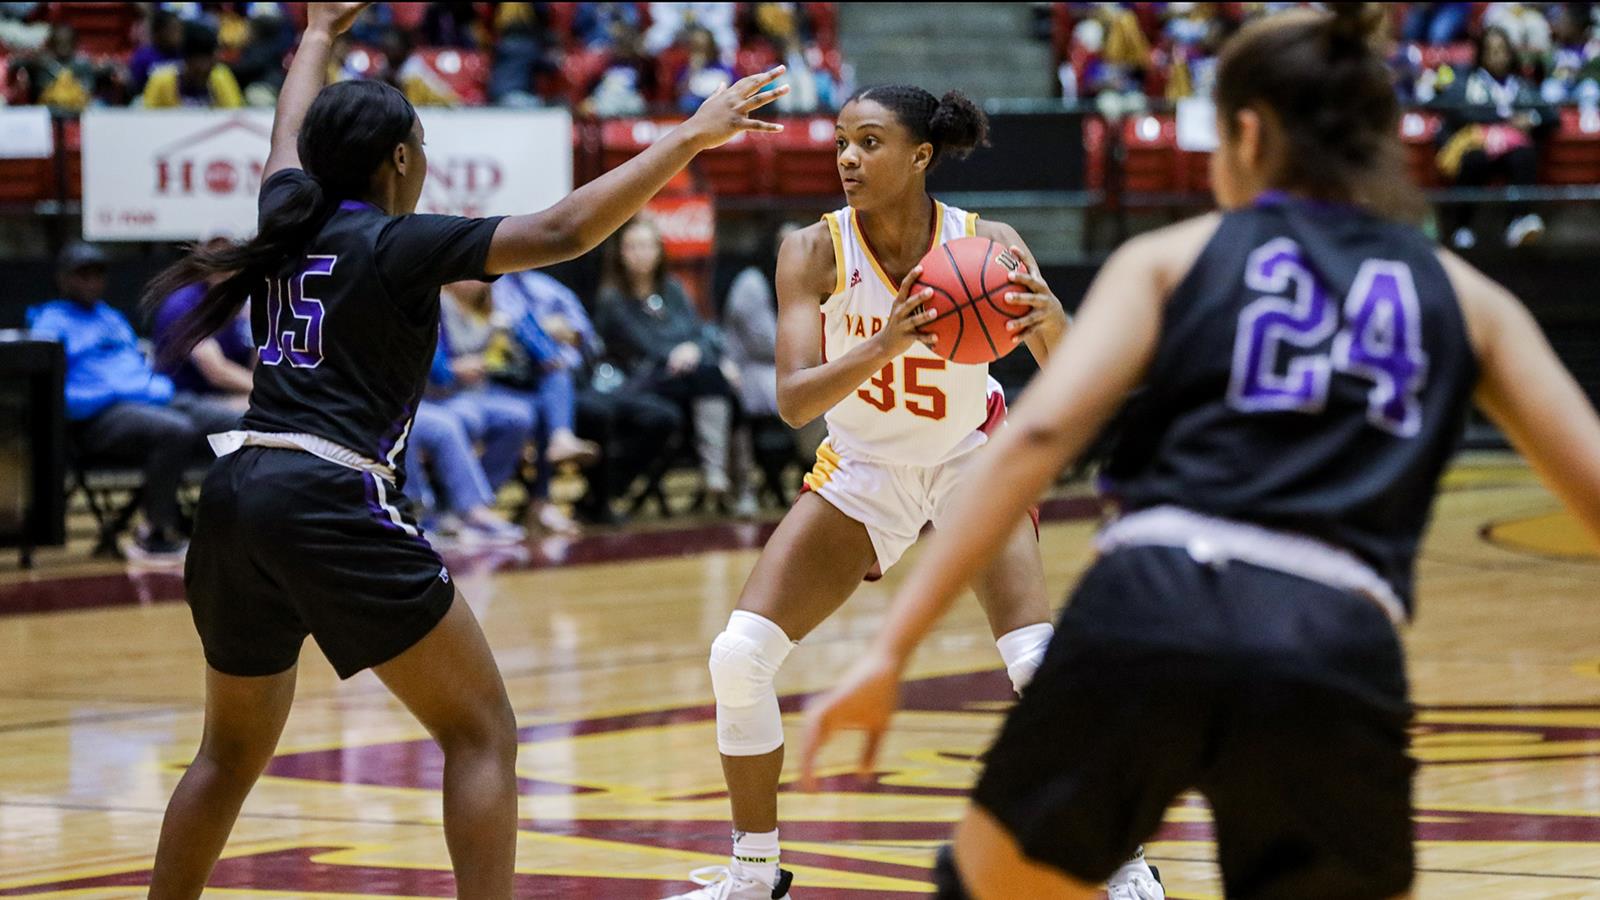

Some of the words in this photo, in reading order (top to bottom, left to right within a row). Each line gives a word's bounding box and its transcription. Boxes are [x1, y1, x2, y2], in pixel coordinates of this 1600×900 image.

[257, 254, 338, 369] 15
[1225, 236, 1430, 438] 24
[857, 356, 947, 422] 35
